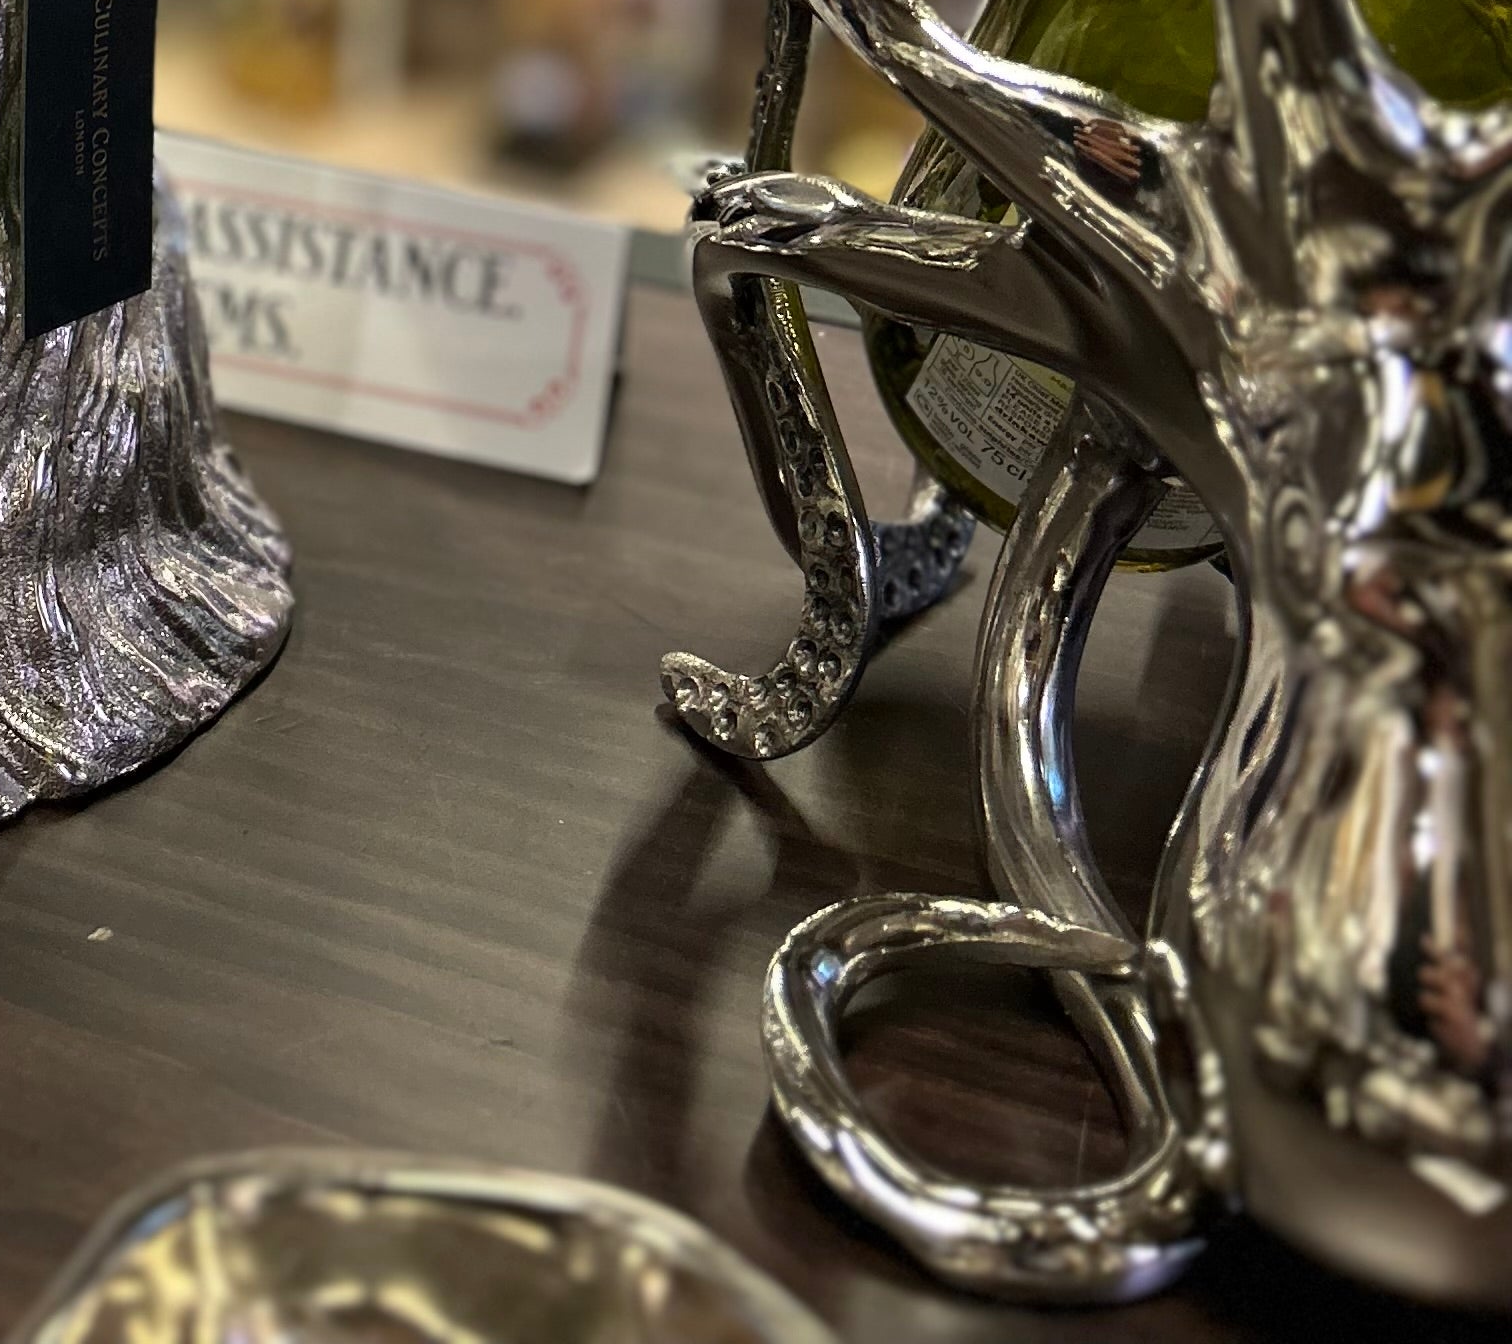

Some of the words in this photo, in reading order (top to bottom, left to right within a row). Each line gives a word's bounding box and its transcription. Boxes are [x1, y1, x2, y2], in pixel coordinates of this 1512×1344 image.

[75, 109, 85, 176] LONDON
[92, 127, 110, 261] CONCEPTS
[981, 439, 1007, 467] 75
